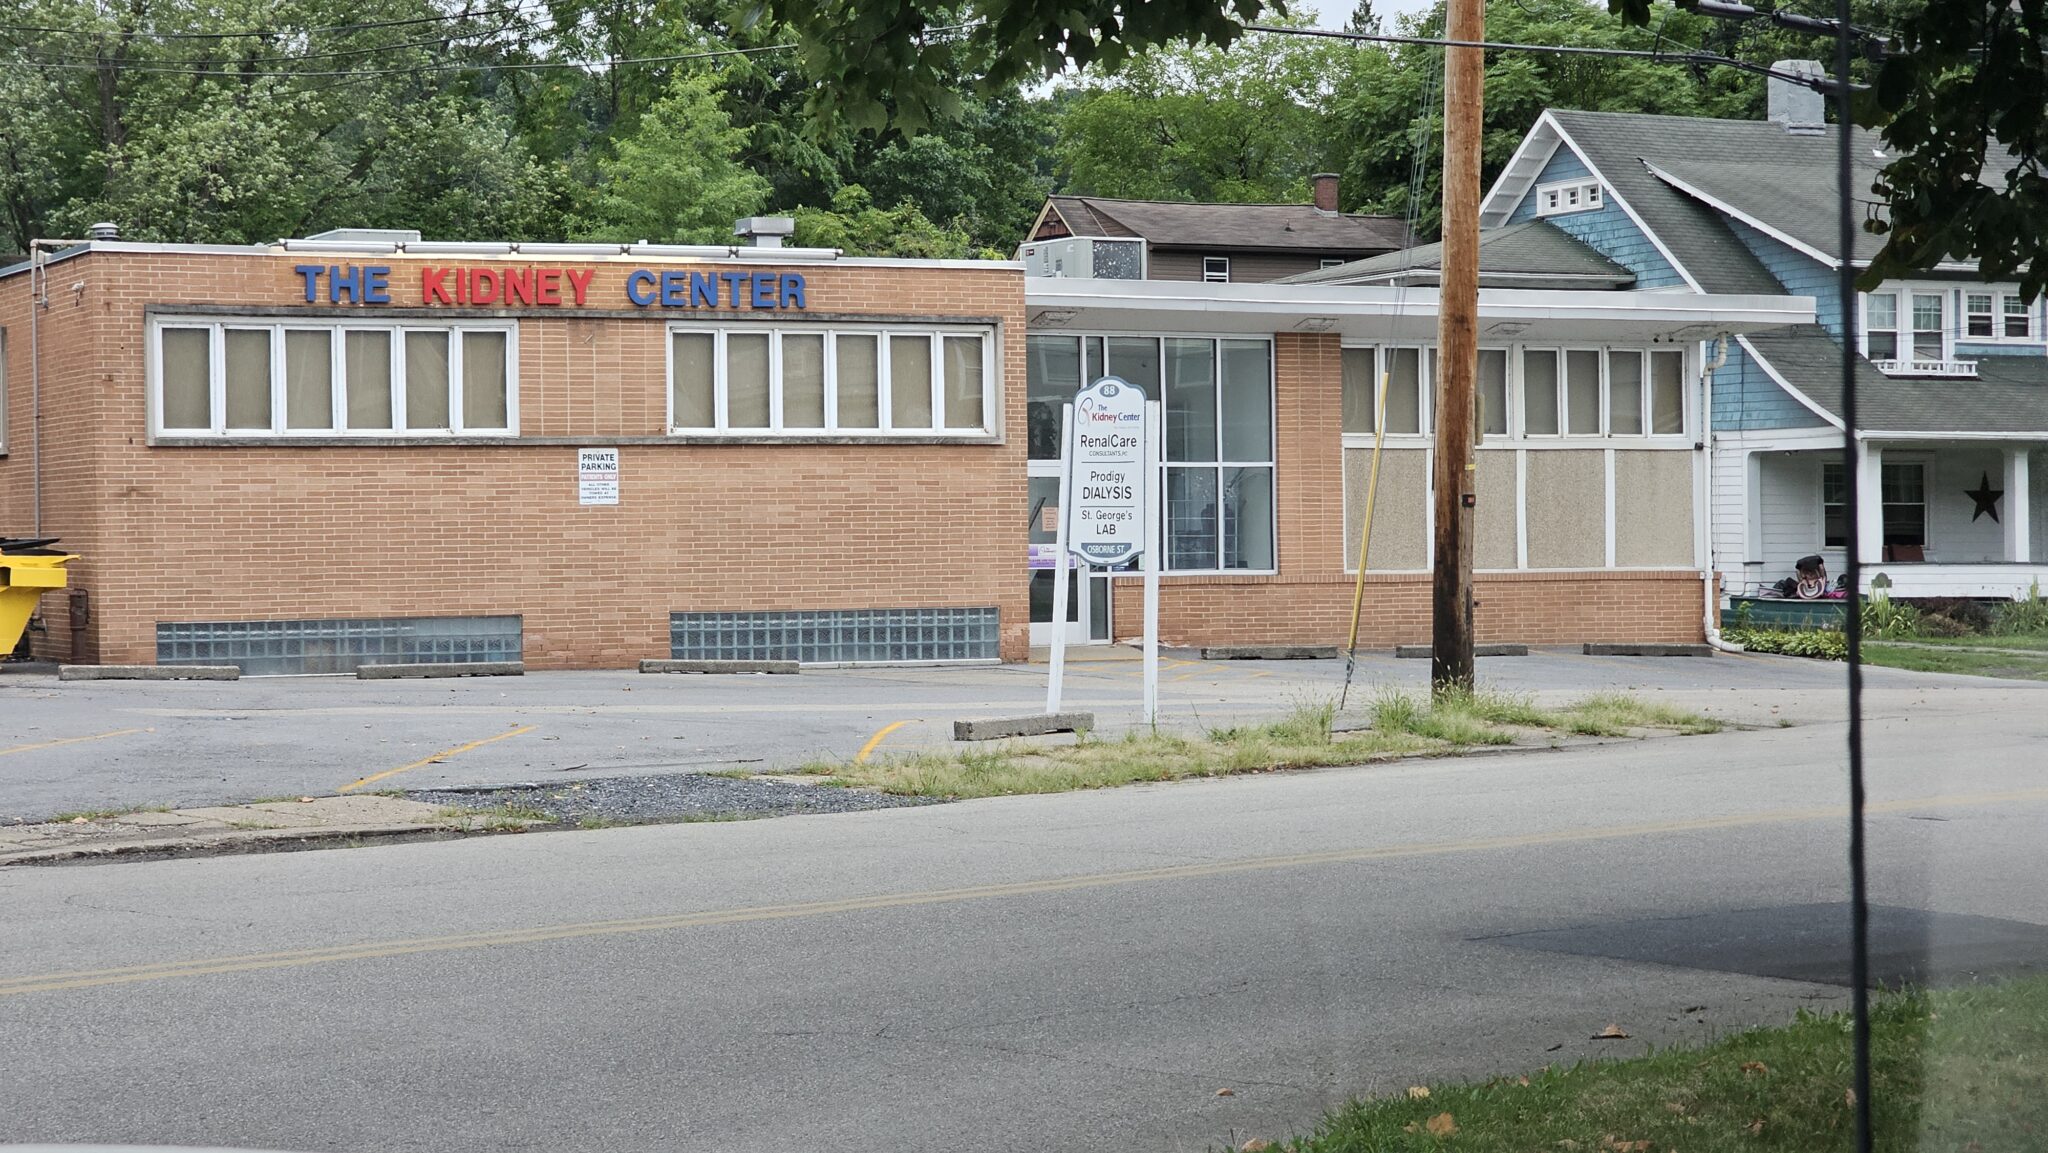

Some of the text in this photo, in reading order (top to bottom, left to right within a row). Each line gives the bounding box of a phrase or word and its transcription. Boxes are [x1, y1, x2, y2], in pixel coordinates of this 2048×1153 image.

[295, 265, 806, 308] THE KIDNEY CENTER
[1103, 385, 1116, 395] 88
[1092, 412, 1140, 423] Kidney Center
[1080, 434, 1137, 448] RenalCare
[1090, 471, 1125, 483] Prodigy
[1083, 486, 1132, 499] DIALYSIS
[1081, 510, 1132, 521] St. George's
[1096, 524, 1116, 535] LAB
[1087, 545, 1126, 554] OSBORNE ST.
